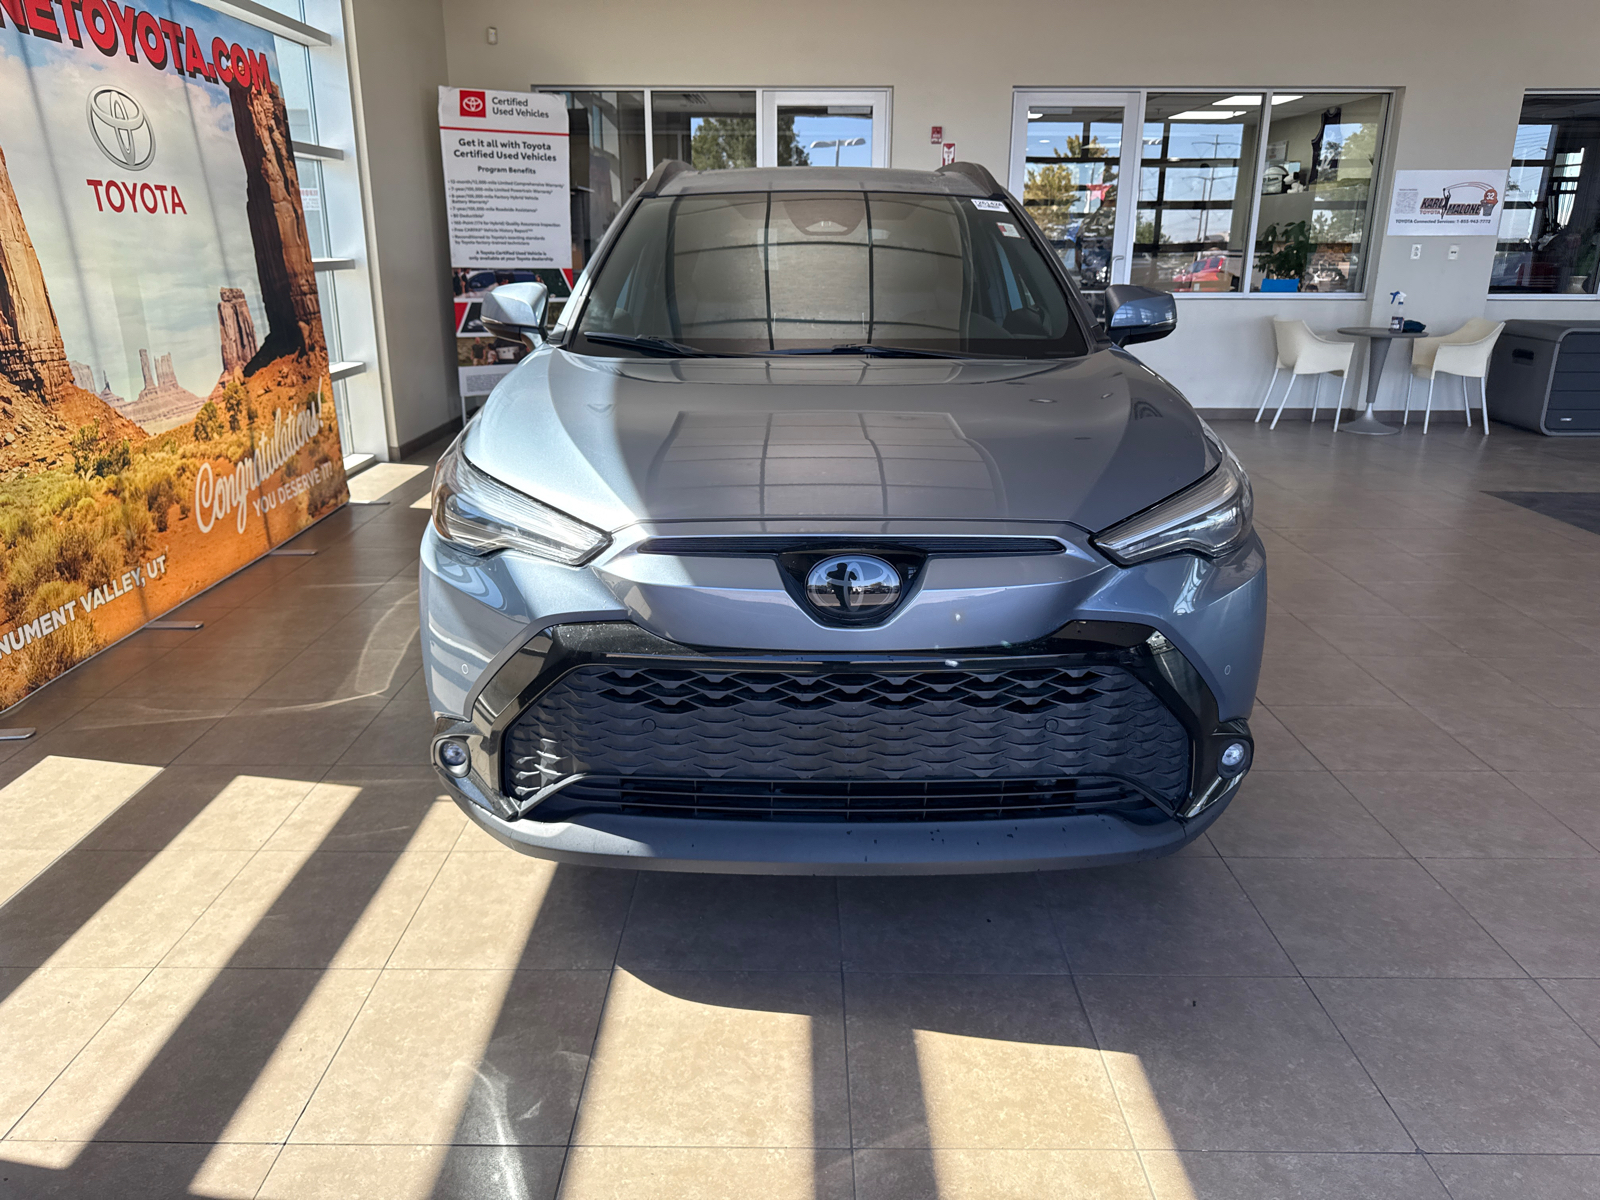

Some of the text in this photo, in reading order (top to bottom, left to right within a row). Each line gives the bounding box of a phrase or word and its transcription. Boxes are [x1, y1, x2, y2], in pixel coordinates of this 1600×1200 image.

[492, 96, 528, 106] Certified
[492, 107, 549, 118] Used Vehicles
[458, 138, 551, 152] Get it all with Toyota
[454, 150, 556, 162] Certified Used Vehicles
[478, 166, 507, 174] Program
[86, 179, 187, 214] TOYOTA
[1446, 204, 1482, 214] MALONE
[195, 374, 324, 534] Congratulations!
[252, 461, 333, 516] YOU DESERVE IT!
[80, 567, 146, 613] VALLEY,
[146, 555, 166, 579] UT
